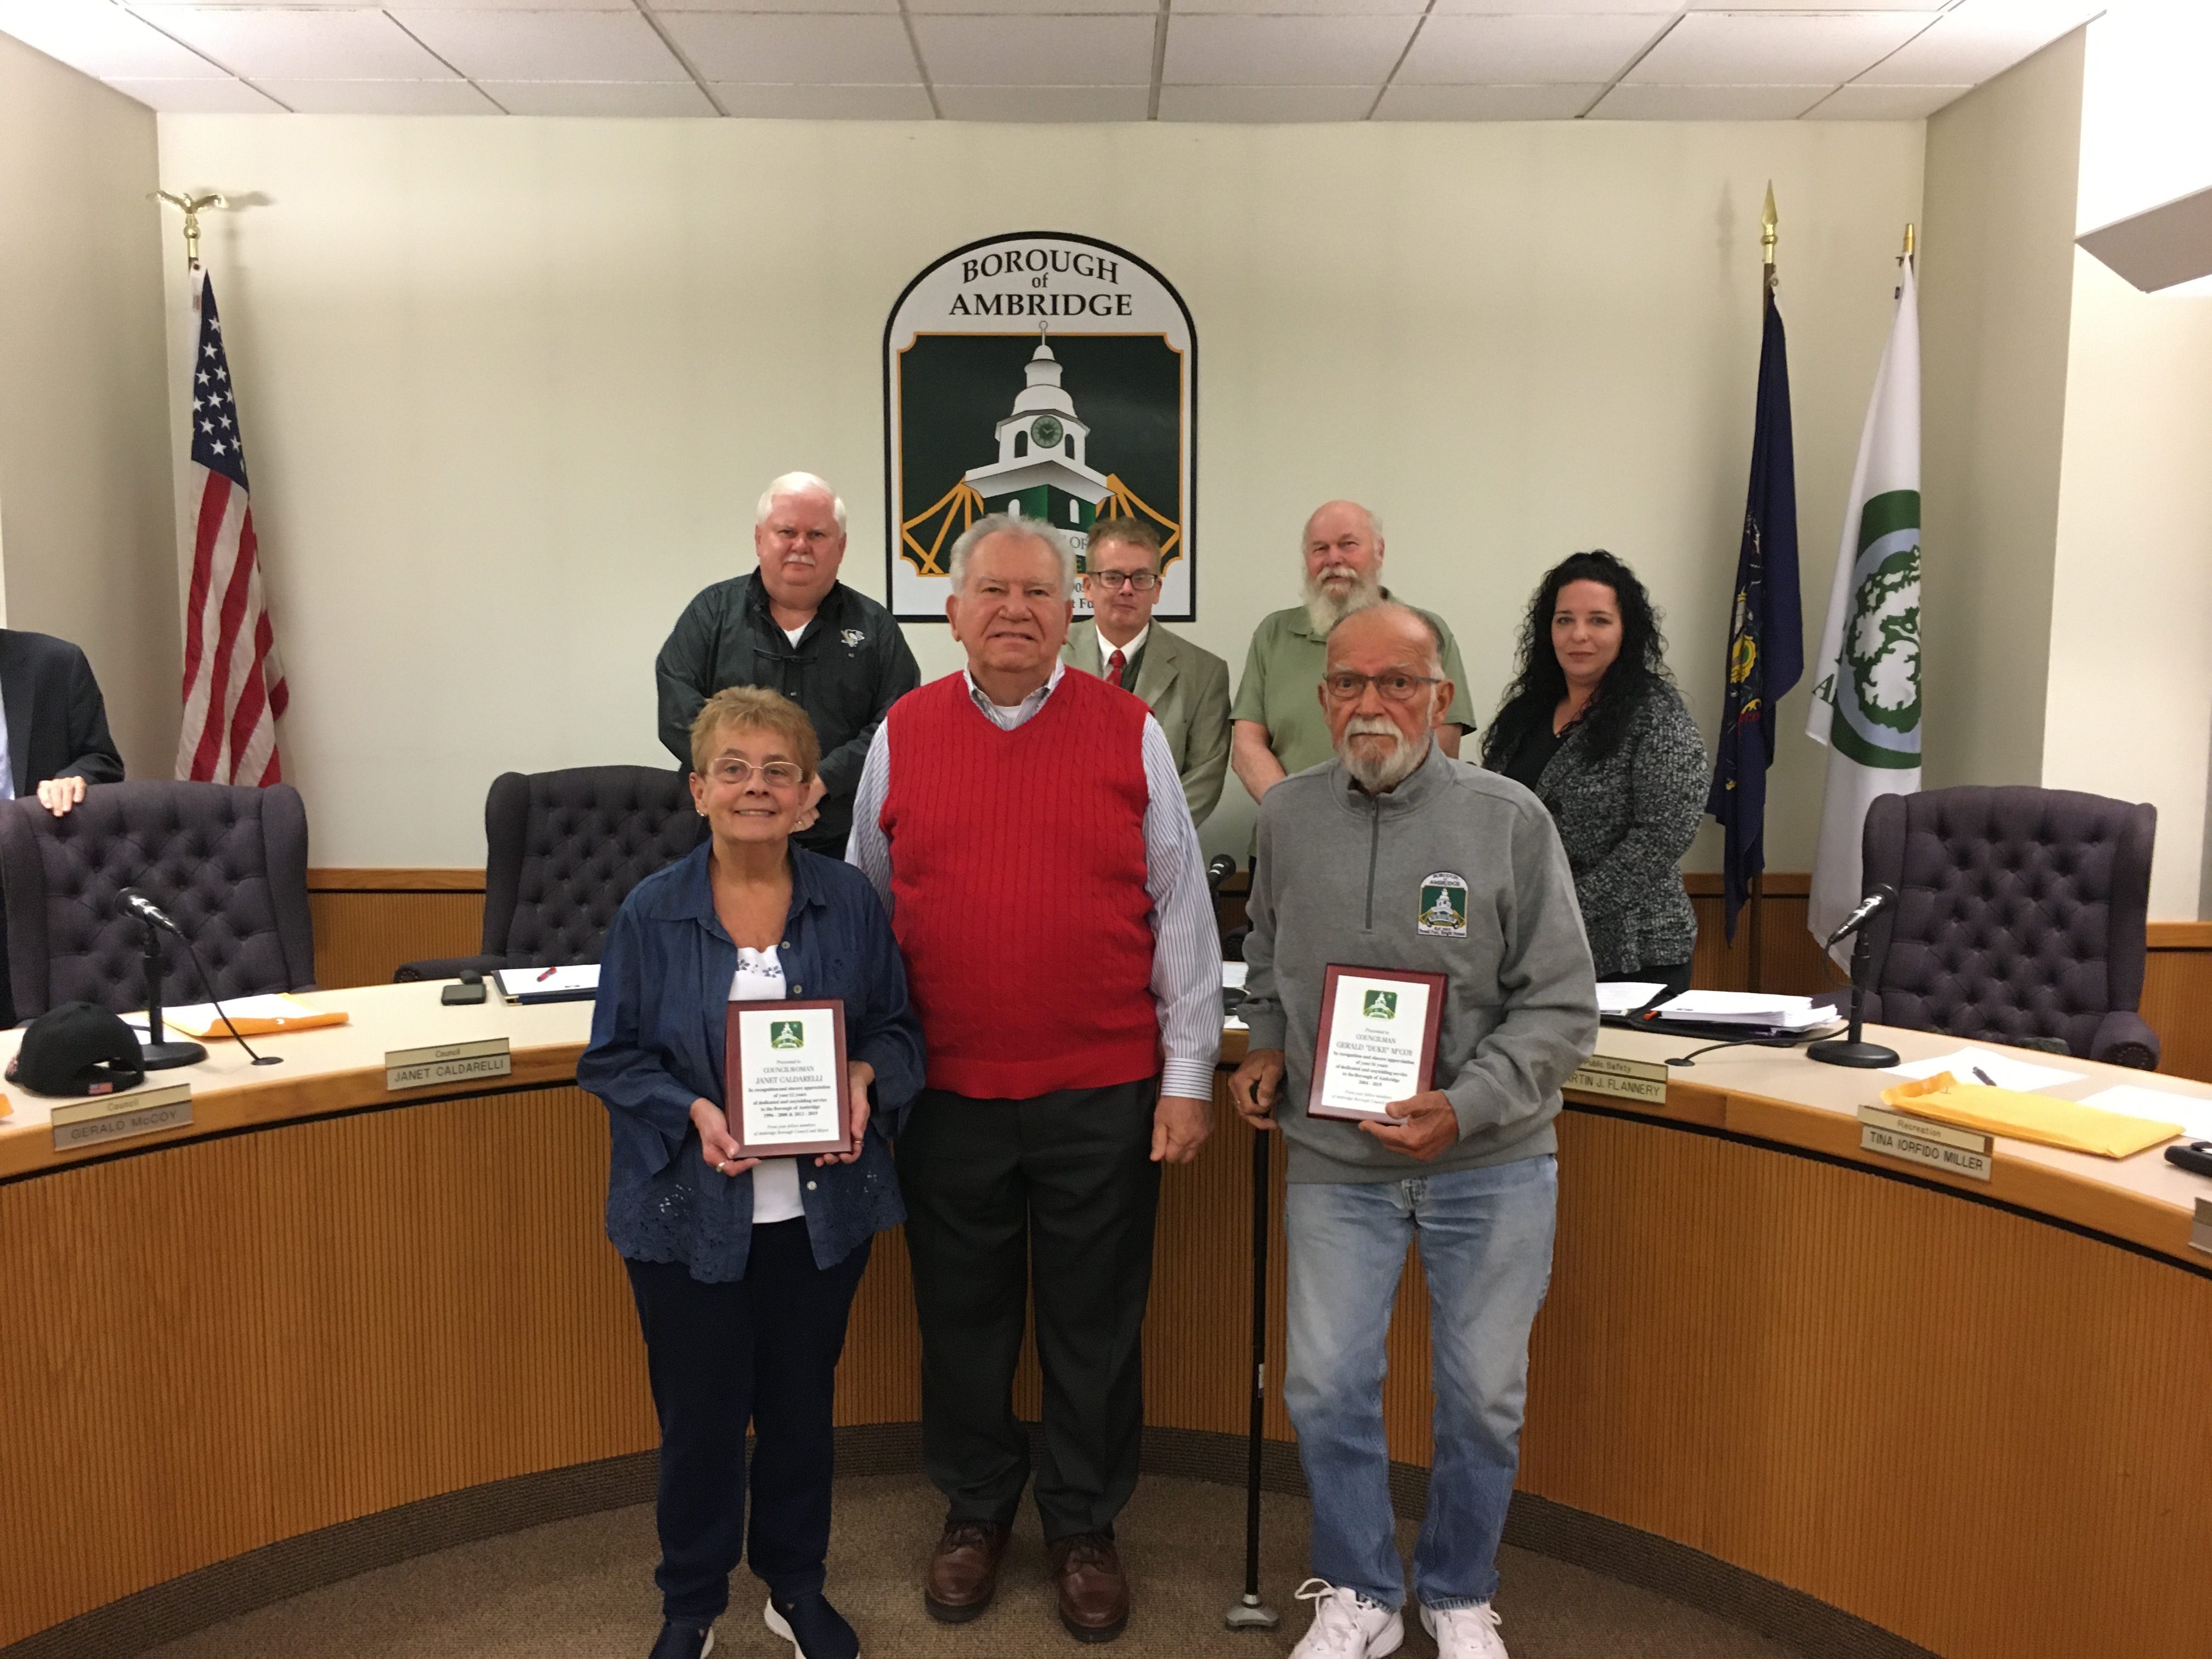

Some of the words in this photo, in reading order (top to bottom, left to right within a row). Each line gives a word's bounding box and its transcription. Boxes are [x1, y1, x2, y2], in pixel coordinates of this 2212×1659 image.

[962, 249, 1119, 285] BOROUGH
[1031, 272, 1049, 288] of
[949, 293, 1133, 317] AMBRIDGE
[1336, 1041, 1364, 1051] GERALD
[1356, 1034, 1396, 1044] COUNCILMAN
[435, 1048, 461, 1058] Council
[394, 1068, 430, 1082] JANET
[436, 1059, 504, 1077] CALDARELLI
[1606, 1062, 1632, 1073] Safety
[780, 1075, 823, 1083] CALDARELLI
[1568, 1074, 1593, 1086] RTIN
[1596, 1078, 1605, 1088] J.
[1607, 1079, 1660, 1097] FLANNERY
[106, 1098, 140, 1111] Council
[70, 1120, 125, 1140] GERALD
[131, 1109, 178, 1127] McCOY
[1897, 1119, 1942, 1138] Recreation
[1870, 1131, 1893, 1148] TINA
[1897, 1138, 1940, 1159] IORFIDO
[1943, 1150, 1984, 1171] MILLER
